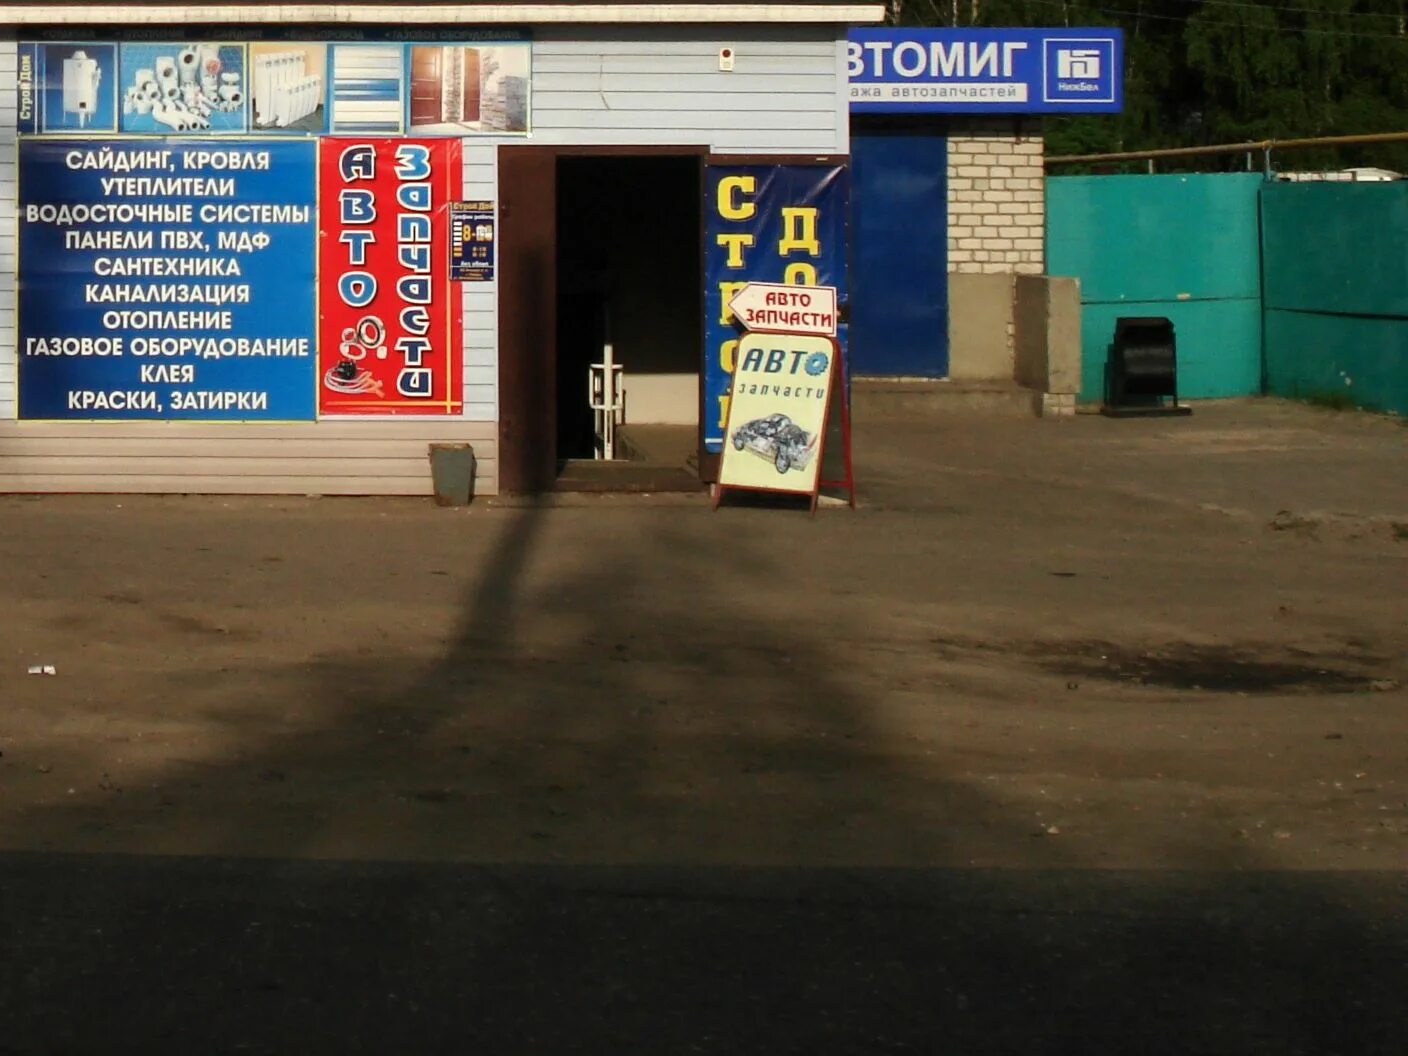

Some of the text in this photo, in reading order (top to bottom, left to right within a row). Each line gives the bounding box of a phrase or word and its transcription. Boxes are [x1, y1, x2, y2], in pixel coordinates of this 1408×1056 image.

[848, 42, 1028, 77] ВТОМИГ
[850, 84, 1016, 97] ажа автозапчастей
[66, 147, 269, 172] САЙДИНГ, КРОВЛЯ
[101, 177, 235, 197] УТЕПЛИТЕЛИ
[26, 204, 309, 226] ВОДОСТОЧНЫЕ СИСТЕМЫ
[65, 230, 270, 254] ПАНЕЛИ ПВХ, МДФ
[94, 257, 241, 277] САНТЕХНИКА
[85, 284, 249, 306] КАНАЛИЗАЦИЯ
[765, 292, 811, 307] АВТО
[102, 310, 232, 330] ОТОПЛЕНИЕ
[746, 309, 832, 327] ЗАПЧАСТИ
[26, 337, 309, 359] ГАЗОВОЕ ОБОРУДОВАНИЕ
[141, 364, 194, 383] КЛЕЯ
[68, 390, 267, 412] КРАСКИ, ЗАТИРКИ
[739, 383, 824, 399] запчасти
